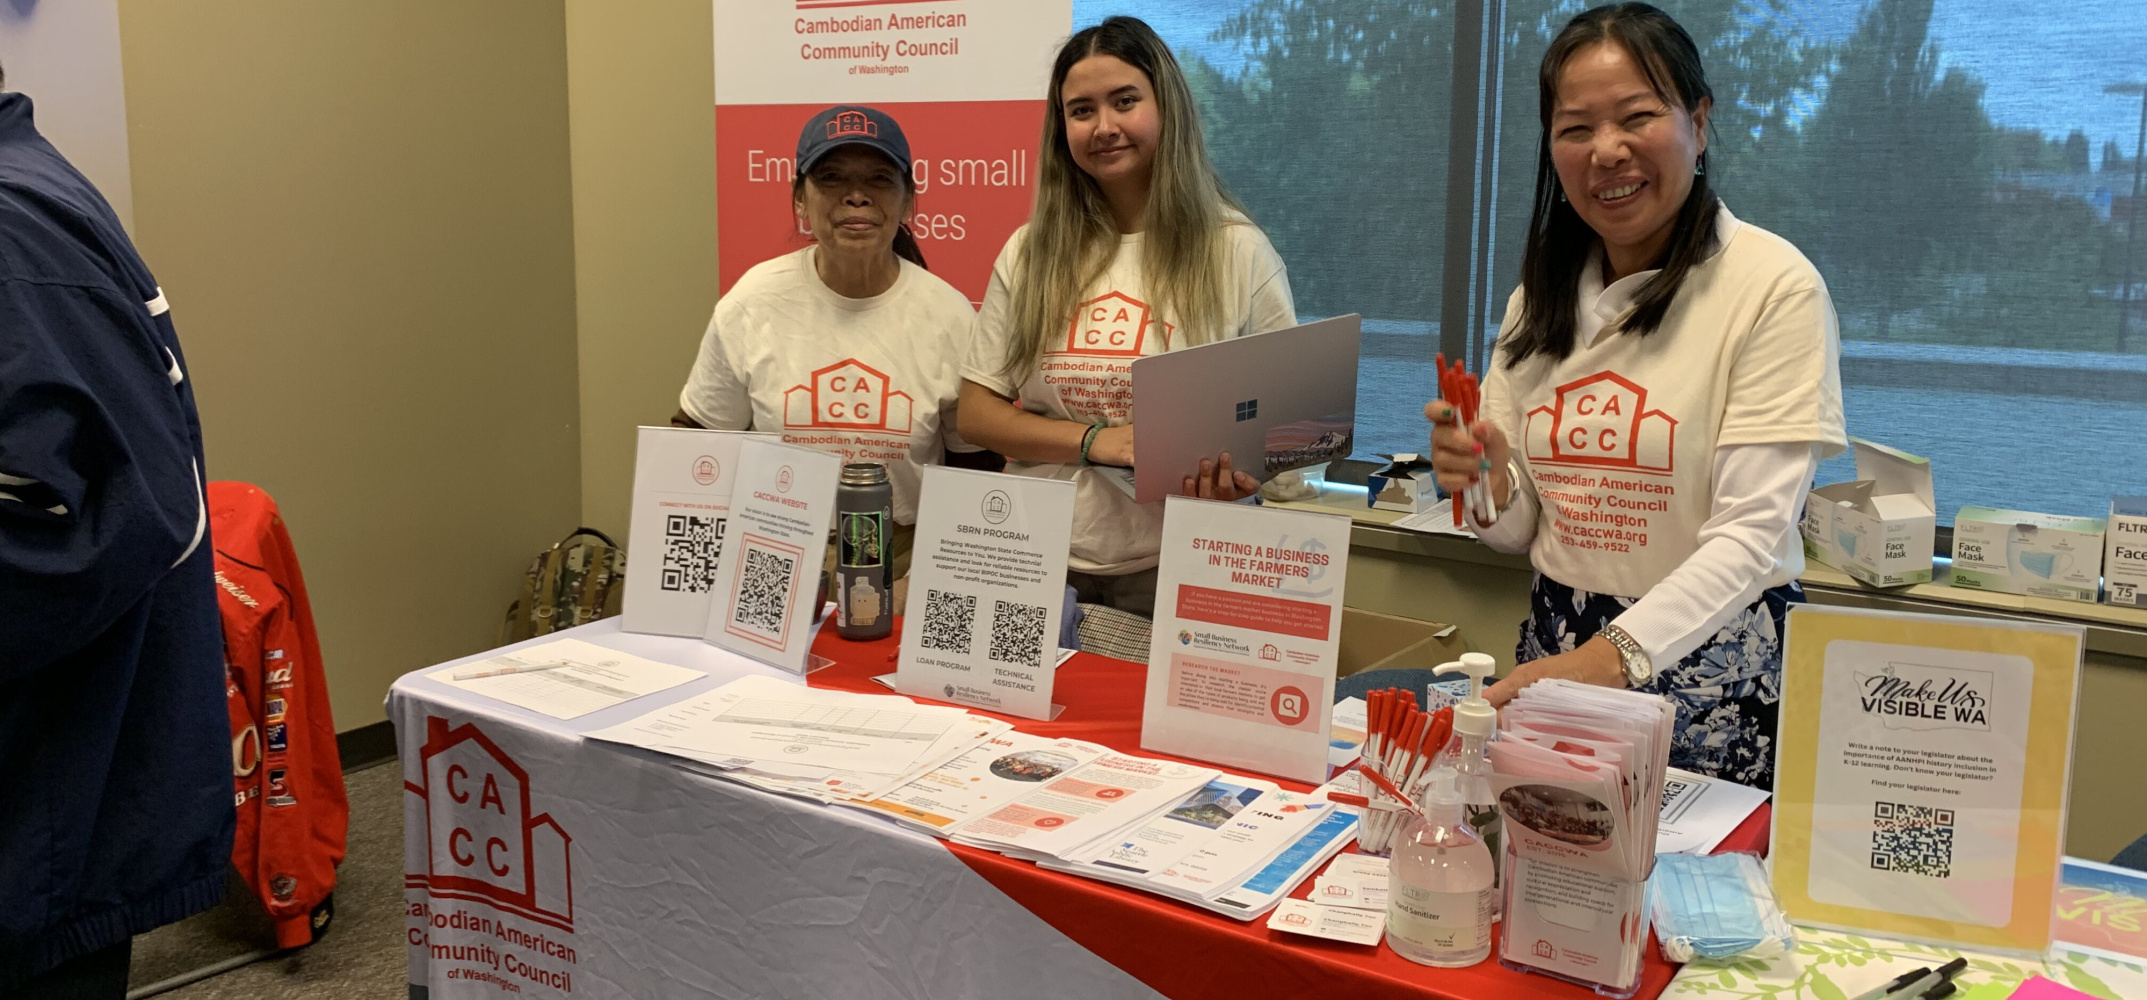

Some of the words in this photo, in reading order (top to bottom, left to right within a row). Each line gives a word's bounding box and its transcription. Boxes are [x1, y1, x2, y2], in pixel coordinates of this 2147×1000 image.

[795, 17, 882, 34] Cambodian
[887, 11, 967, 31] American
[800, 41, 890, 61] Community
[896, 38, 959, 57] Council
[848, 66, 855, 75] of
[859, 63, 909, 76] Washington
[939, 149, 1026, 187] small
[1040, 361, 1103, 373] Cambodian
[1044, 375, 1106, 388] Community
[1061, 387, 1073, 396] of
[1074, 387, 1133, 400] Washingto
[1061, 398, 1133, 410] www.caccwa.or
[782, 434, 851, 445] Cambodian
[854, 436, 910, 449] American
[859, 449, 904, 460] Council
[1532, 469, 1596, 487] Cambodian
[1600, 477, 1675, 495] American
[753, 490, 779, 503] CACCWA
[781, 497, 808, 510] WEBSITE
[1538, 486, 1602, 509] Community
[1606, 495, 1668, 512] Council
[1561, 506, 1647, 528] Washington
[1808, 515, 1819, 526] Face
[956, 524, 981, 536] SBRN
[982, 527, 1029, 542] PROGRAM
[1807, 522, 1820, 534] Mask
[2118, 522, 2147, 533] FLTR
[940, 538, 963, 548] Bringing
[964, 542, 996, 553] Washington
[997, 546, 1011, 554] State
[1012, 549, 1042, 559] Commerce
[1192, 537, 1252, 556] STARTING
[1254, 544, 1263, 557] A
[1265, 546, 1329, 566] BUSINESS
[1561, 535, 1630, 553] 253-459-9522
[1886, 543, 1904, 551] Face
[1959, 542, 1982, 552] Face
[939, 546, 966, 556] Resources
[997, 555, 1018, 565] provide
[1885, 551, 1906, 559] Mask
[1958, 551, 1984, 562] Mask
[932, 554, 959, 563] assistance
[992, 563, 1012, 571] reliable
[1013, 566, 1040, 576] resources
[936, 562, 956, 571] support
[967, 567, 980, 575] local
[981, 569, 998, 578] BIPOC
[999, 572, 1029, 582] businesses
[1208, 554, 1221, 566] IN
[1223, 555, 1246, 569] THE
[1249, 560, 1309, 578] FARMERS
[953, 573, 980, 583] non-profit
[981, 578, 1019, 589] organizations.
[1231, 571, 1283, 588] MARKET
[1956, 575, 1966, 583] 50
[2117, 586, 2133, 598] 75
[1192, 638, 1222, 648] Resiliency
[1223, 642, 1250, 653] Network
[1193, 631, 1211, 640] Small
[1211, 634, 1236, 644] Business
[916, 656, 935, 665] LOAN
[936, 660, 971, 672] PROGRAM
[994, 668, 1034, 681] TECHNICAL
[992, 678, 1035, 692] ASSISTANCE
[1865, 675, 1936, 703] Make
[1939, 677, 1985, 707] Us
[1861, 696, 1947, 721] VISIBLE
[1954, 706, 1987, 725] WA
[1848, 742, 1867, 750] Write
[1920, 749, 1954, 760] legislator
[1956, 754, 1978, 762] about
[1979, 756, 1992, 764] the
[1843, 758, 1859, 766] K-12
[1914, 766, 1934, 775] know
[1935, 770, 1952, 778] your
[1954, 771, 1993, 782] legislator?
[1895, 756, 1924, 765] AANHPI
[1926, 759, 1952, 769] history
[1953, 762, 1987, 772] inclusion
[1871, 779, 1887, 787] Find
[1888, 782, 1904, 790] your
[1906, 783, 1940, 794] legislator
[1524, 838, 1589, 858] CACCWA
[1410, 907, 1440, 920] Sanitizer
[2056, 903, 2147, 933] VIS
[405, 899, 492, 934] aodian
[495, 920, 577, 965] American
[408, 927, 500, 971] Cmunity
[504, 953, 572, 993] Council
[447, 968, 460, 979] of
